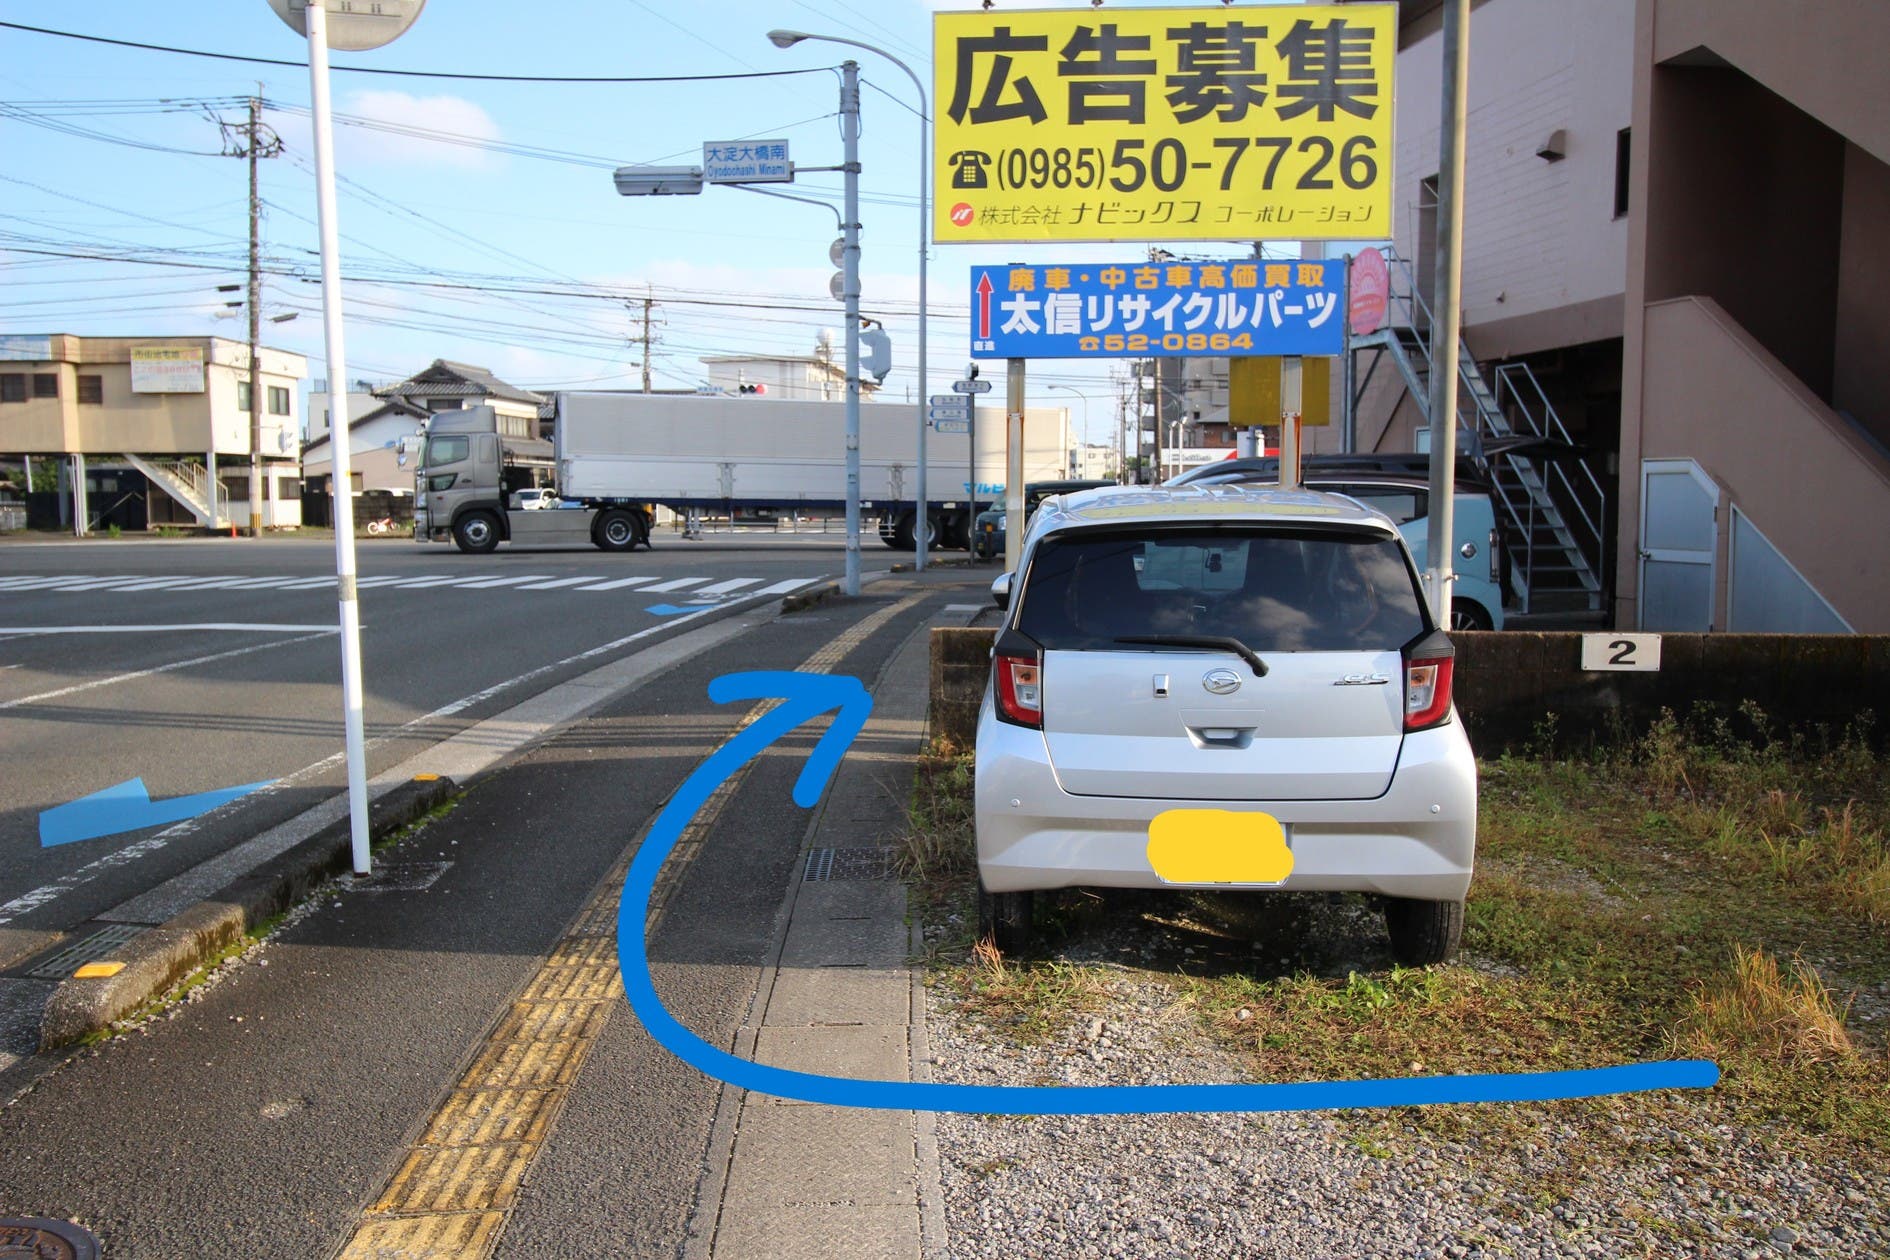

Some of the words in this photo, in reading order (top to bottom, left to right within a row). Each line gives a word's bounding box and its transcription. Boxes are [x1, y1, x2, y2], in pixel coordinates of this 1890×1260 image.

[947, 18, 1379, 126] 広告募集
[707, 145, 785, 162] 大淀大橋南
[998, 135, 1378, 193] (0985)50-7726
[759, 163, 785, 176] Minami
[979, 205, 1061, 226] 株式会社
[1068, 201, 1201, 225] ナビックス
[1215, 204, 1374, 224] コーポレーション
[1008, 263, 1325, 292] 廃車・中古車高価買取
[1000, 291, 1337, 335] 太信リサイクルパーツ
[1103, 333, 1254, 351] 52-0864
[1608, 640, 1637, 665] 2
